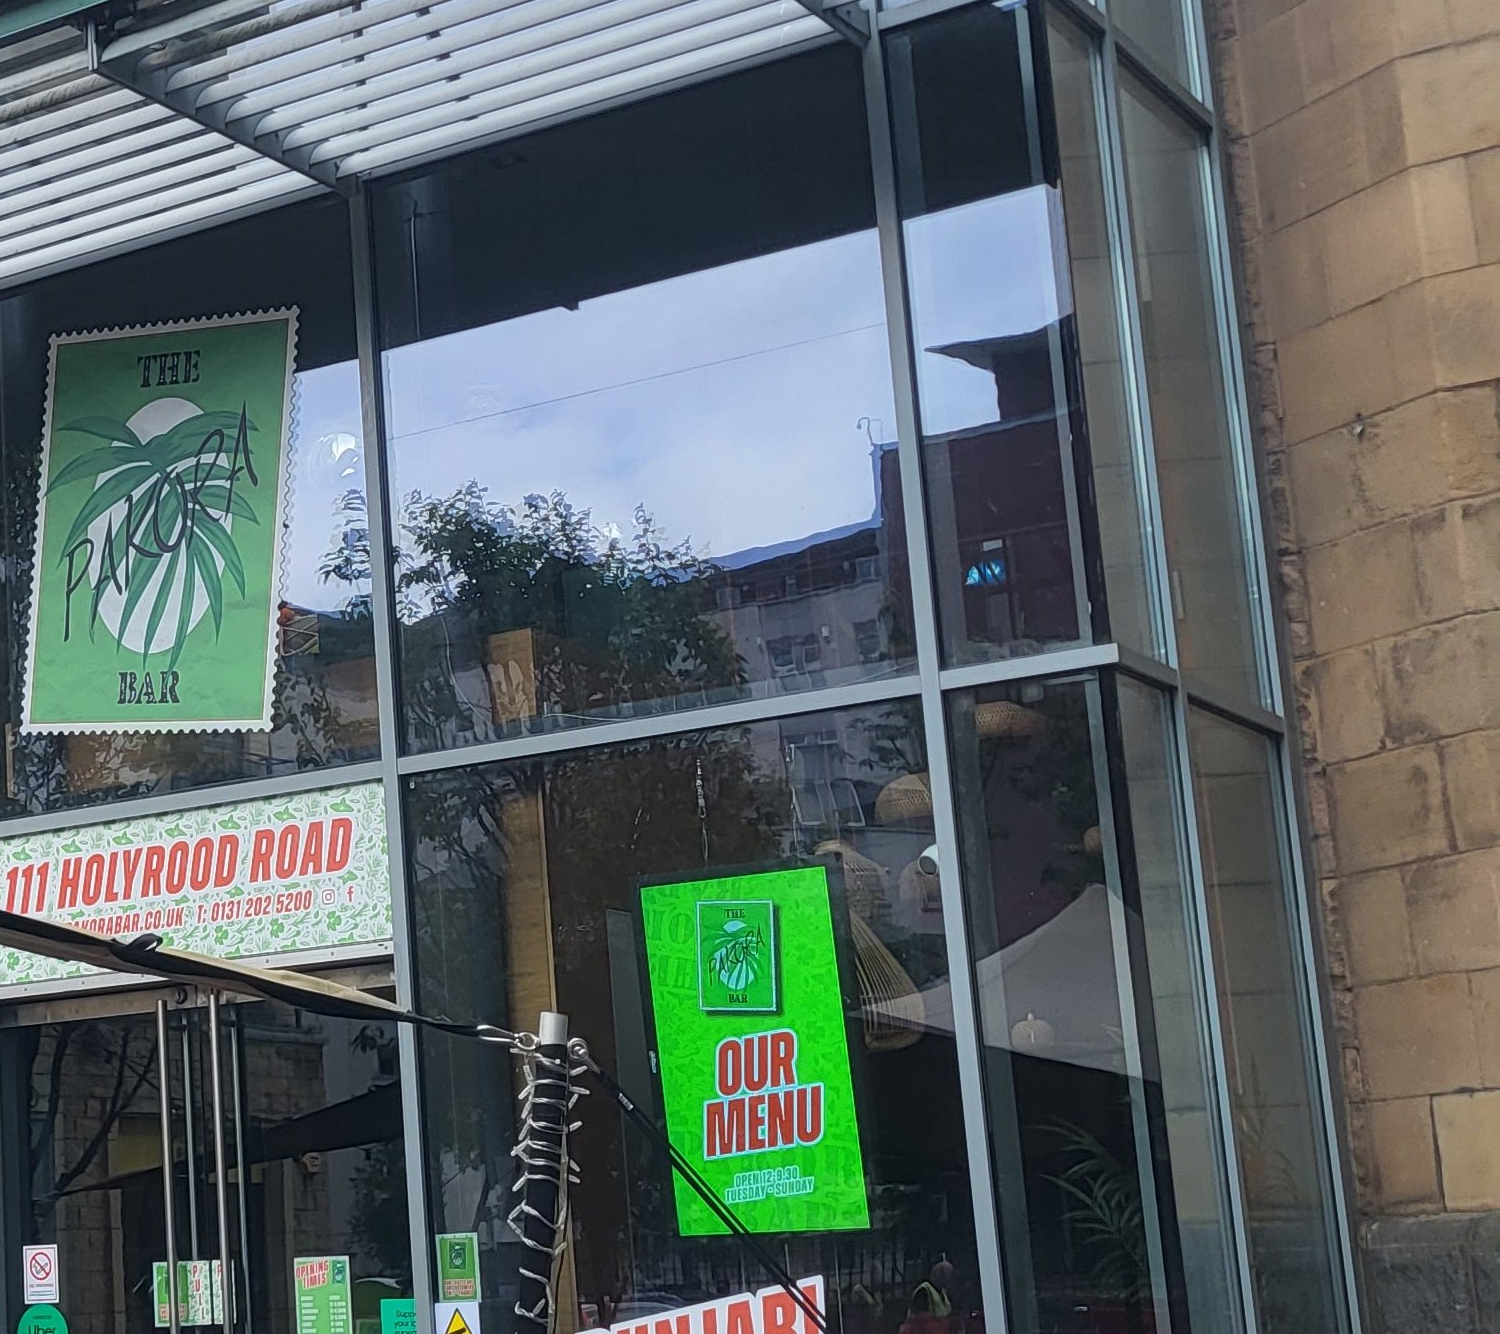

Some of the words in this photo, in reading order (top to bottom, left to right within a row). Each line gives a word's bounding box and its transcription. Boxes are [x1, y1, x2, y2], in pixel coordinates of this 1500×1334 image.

[137, 350, 201, 389] THE
[63, 399, 259, 643] PAKORA
[117, 669, 181, 706] BAR
[4, 861, 51, 914] 111
[56, 833, 241, 910] HOLYROOD
[248, 816, 354, 884] ROAD
[210, 899, 242, 922] 0131
[244, 896, 272, 918] 202
[275, 890, 313, 914] 5200
[723, 908, 746, 919] THE
[708, 922, 766, 988] PAKORA
[728, 993, 749, 1004] BAR
[716, 1031, 796, 1097] OUR
[705, 1084, 823, 1158] MENU
[726, 1185, 767, 1203] TUESDAY
[775, 1178, 814, 1196] SUNDAY
[735, 1172, 760, 1188] OPEN
[296, 1260, 329, 1279] OPENING
